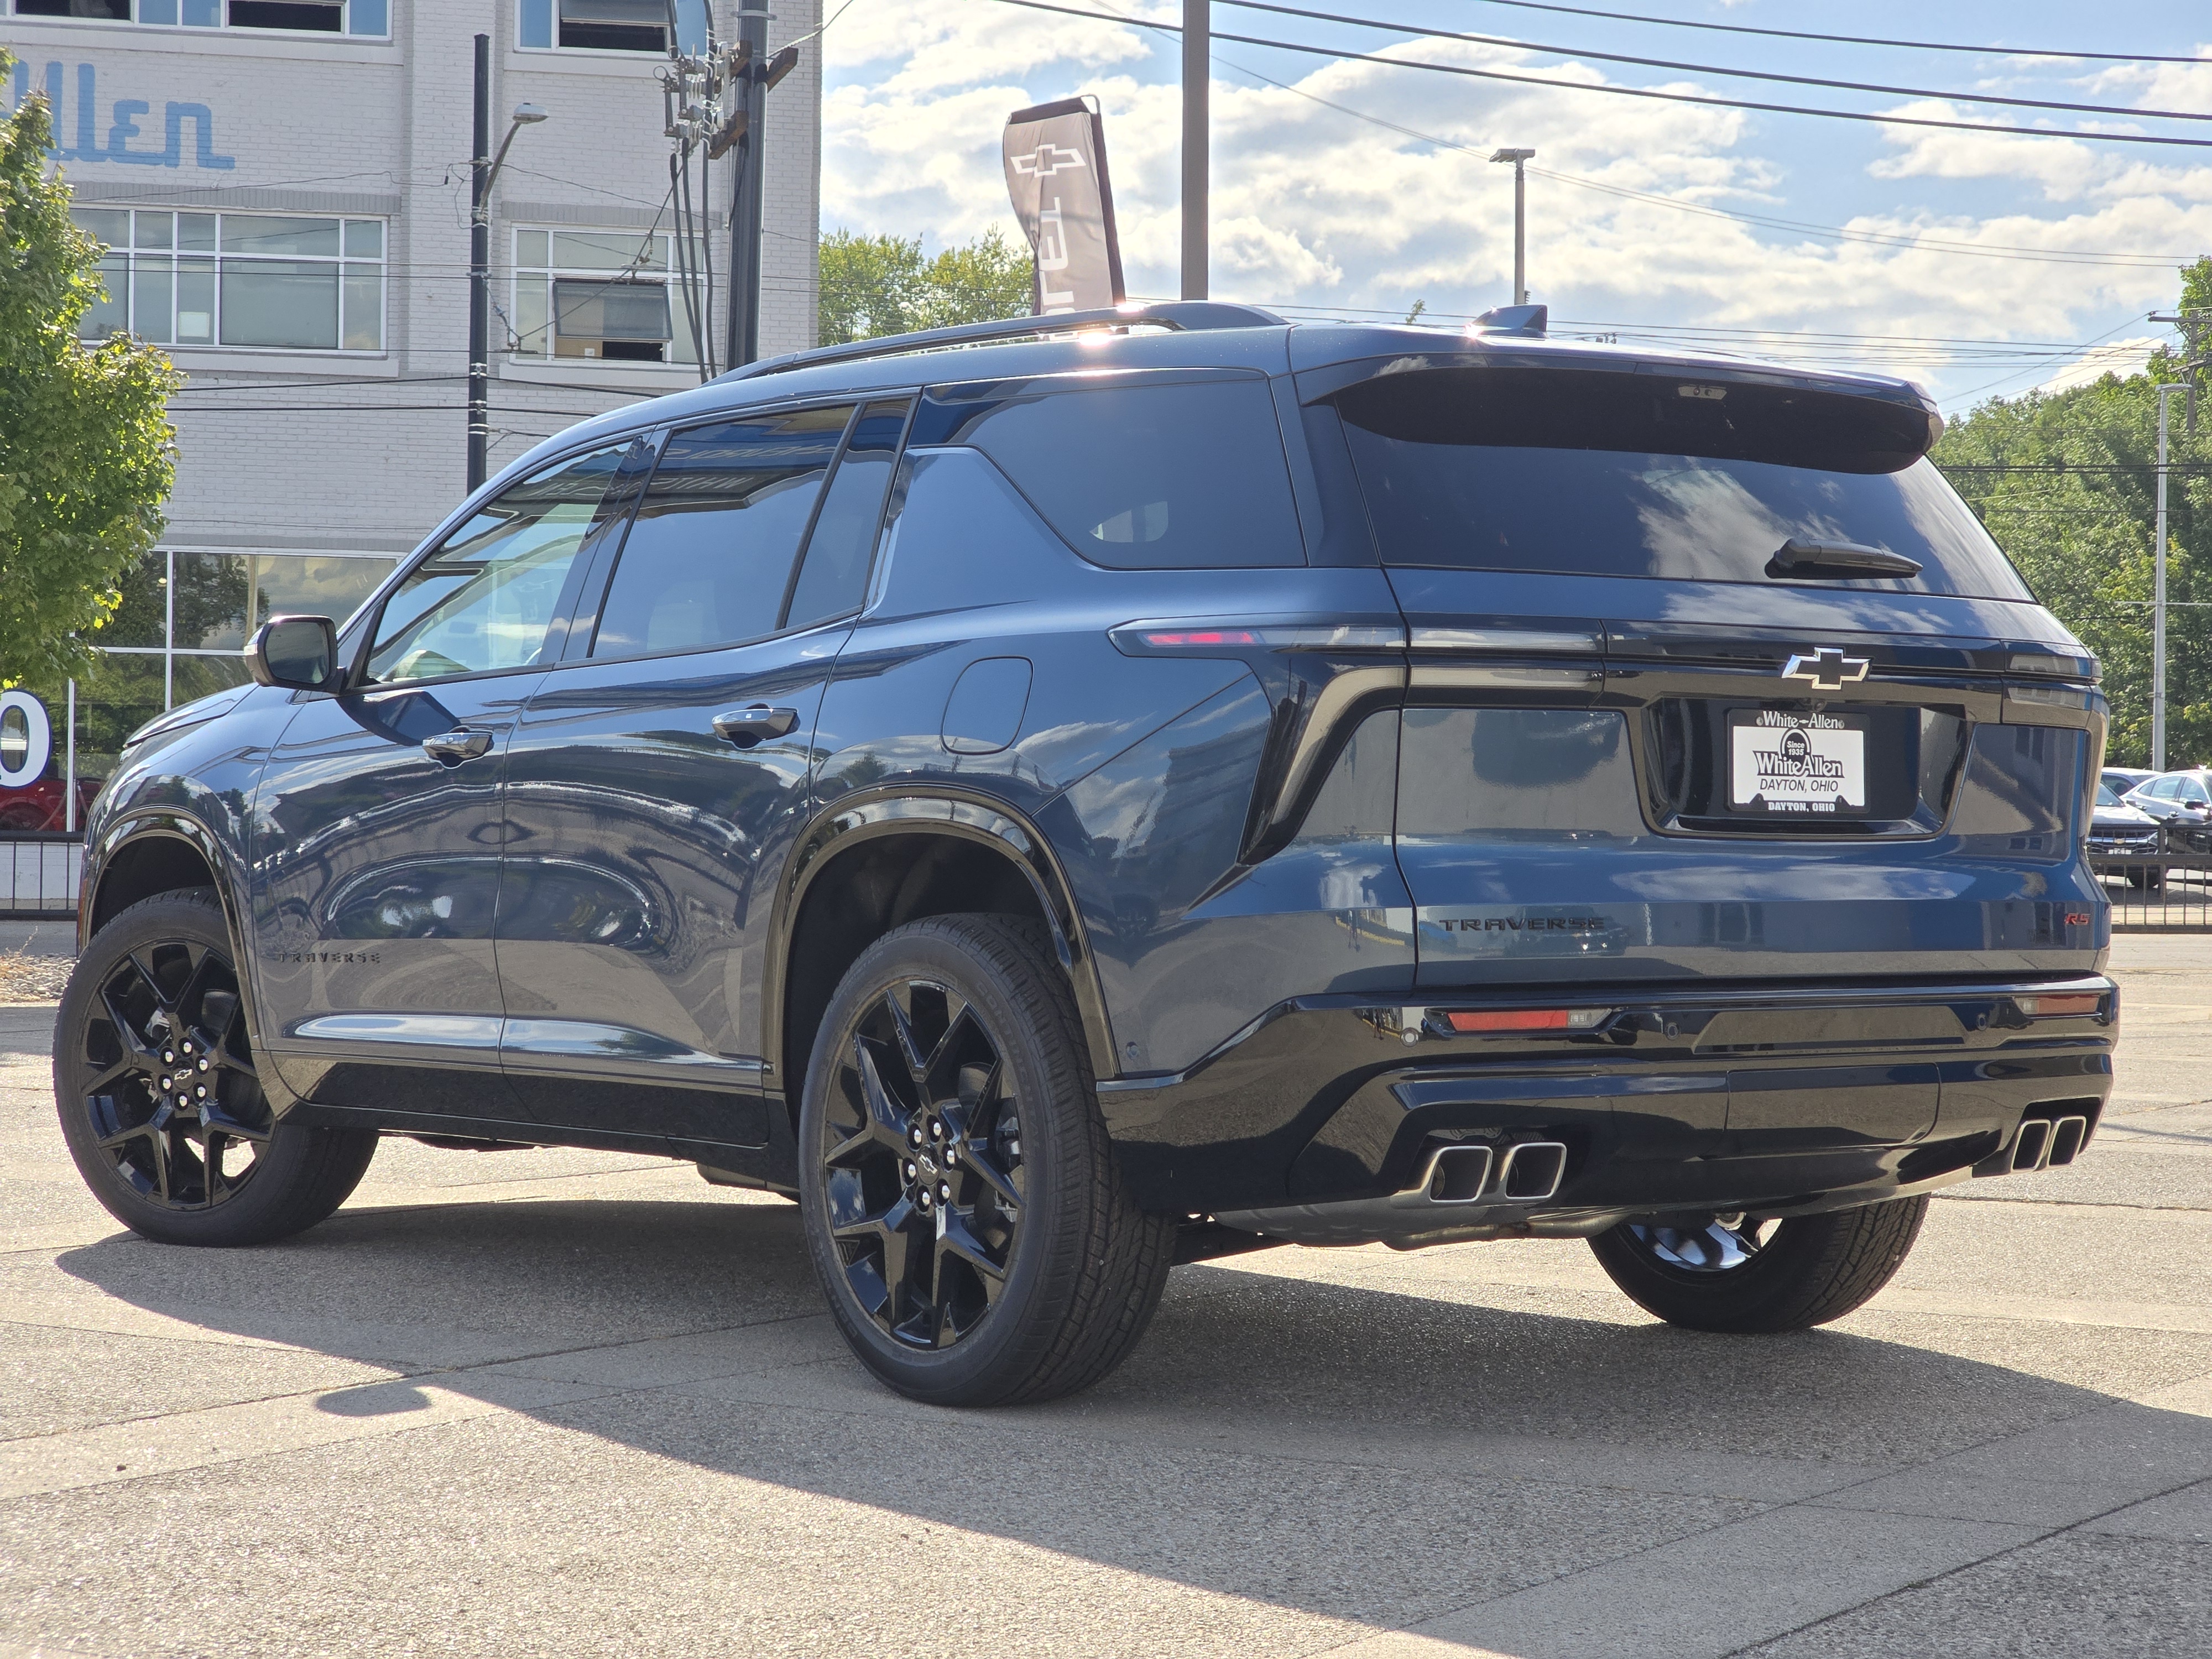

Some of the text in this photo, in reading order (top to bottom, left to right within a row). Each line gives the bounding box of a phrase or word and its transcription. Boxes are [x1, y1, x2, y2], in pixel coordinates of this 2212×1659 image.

[1, 60, 236, 170] llen
[1760, 778, 1839, 793] DAYTON, OHIO
[1768, 802, 1835, 812] DAYTON, OHIO
[1439, 917, 1605, 931] TRAVERSE
[2064, 912, 2090, 925] RS
[275, 952, 380, 963] TRAVERSE
